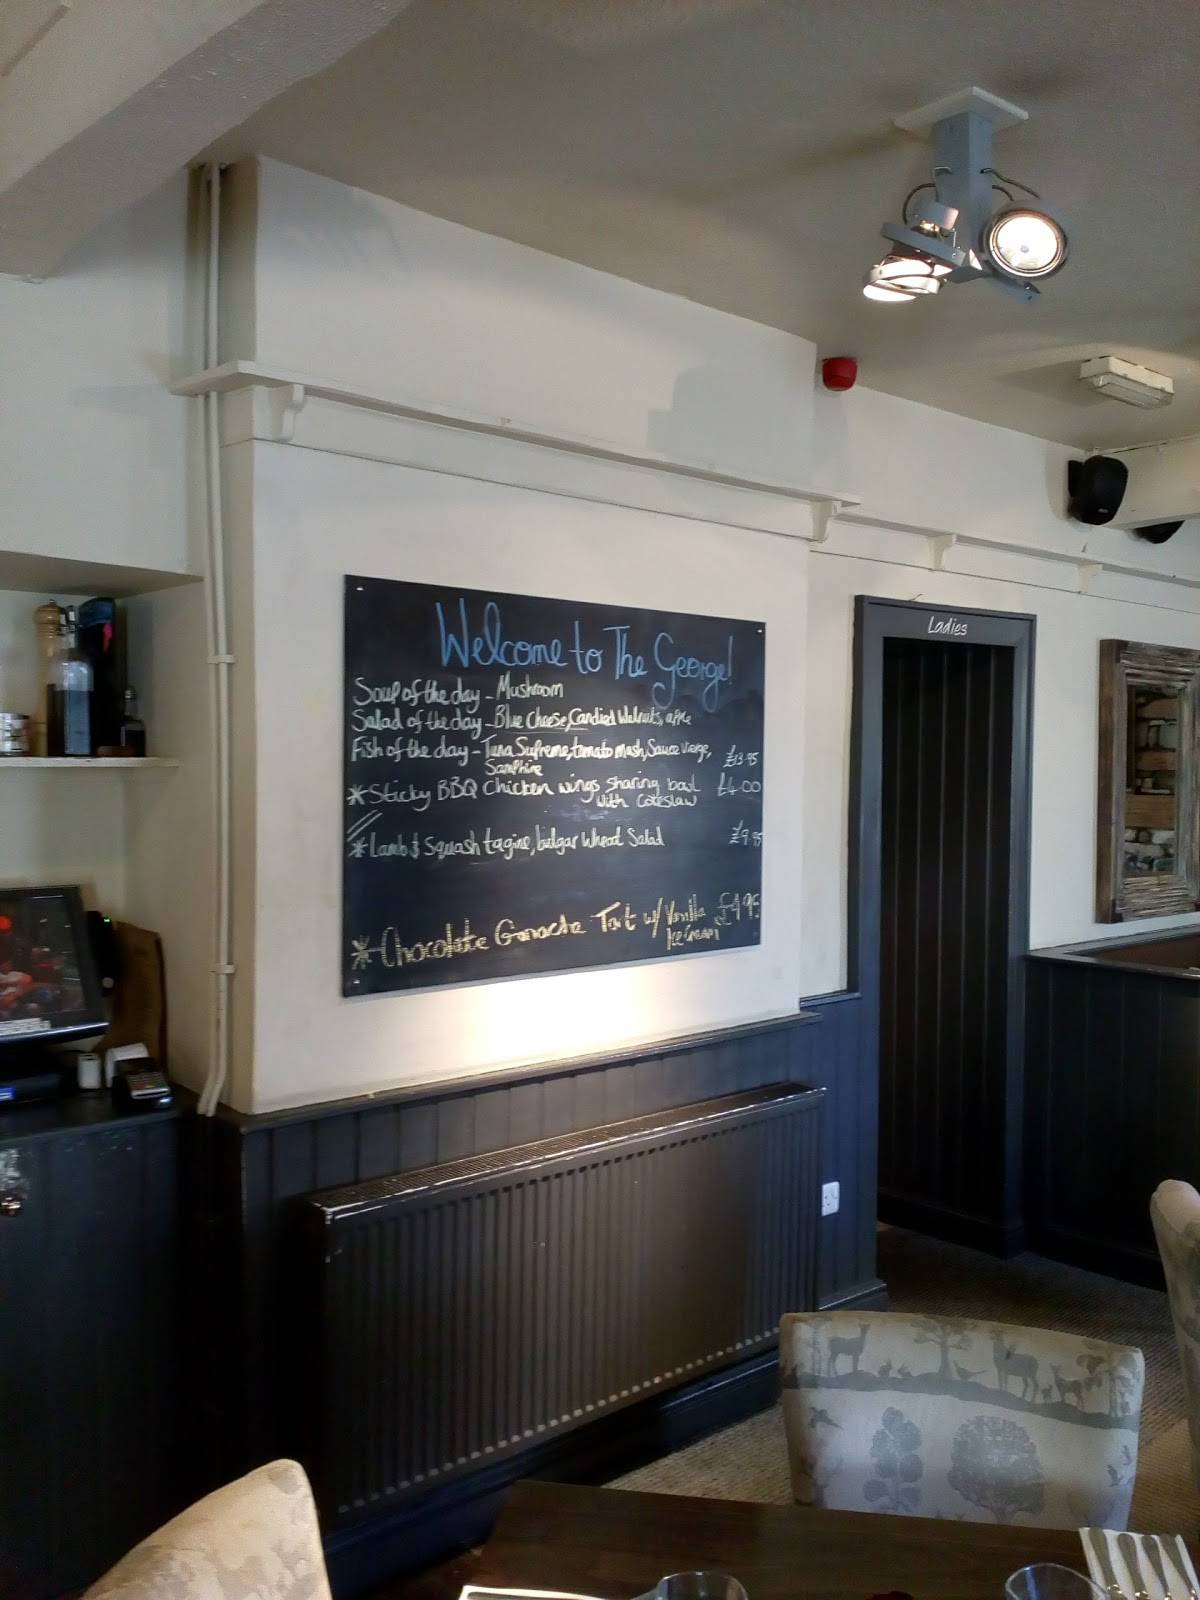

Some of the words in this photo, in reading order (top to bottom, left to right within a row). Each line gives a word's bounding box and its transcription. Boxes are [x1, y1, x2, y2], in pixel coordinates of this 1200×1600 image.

[928, 615, 968, 636] Ladies
[435, 598, 568, 668] Welcome
[568, 620, 604, 675] to
[602, 625, 648, 680] The
[651, 632, 734, 713] George!
[353, 676, 402, 706] Soup
[402, 678, 424, 706] of
[423, 680, 451, 705] the
[451, 676, 481, 714] day
[496, 671, 564, 700] Mushroom
[351, 708, 404, 732] Salad
[407, 710, 425, 734] of
[424, 711, 451, 732] the
[450, 707, 482, 740] day
[495, 703, 524, 729] Blue
[351, 735, 384, 762] Fish
[386, 736, 405, 762] of
[404, 737, 432, 759] the
[433, 734, 470, 767] day
[480, 734, 515, 759] Tuna
[368, 780, 432, 812] Sticky
[437, 775, 479, 801] BBQ
[558, 773, 600, 803] wings
[369, 832, 408, 857] Lamb
[423, 830, 481, 859] Squash
[626, 825, 666, 848] Salad
[380, 917, 491, 969] Chocolate
[590, 901, 638, 933] Tart
